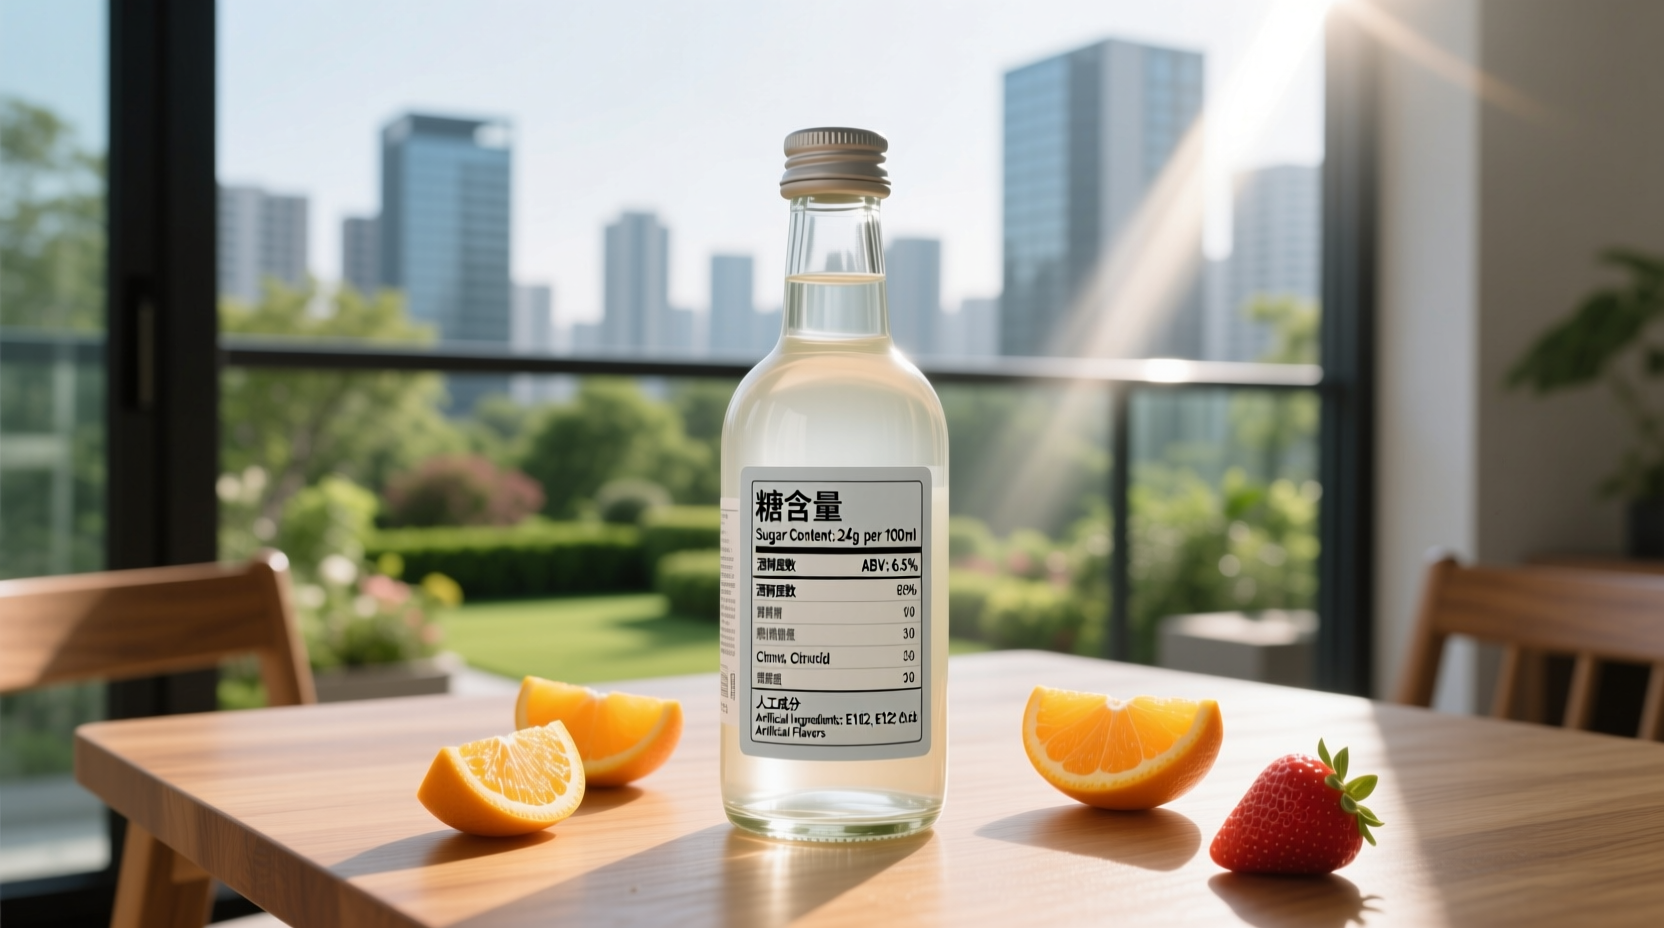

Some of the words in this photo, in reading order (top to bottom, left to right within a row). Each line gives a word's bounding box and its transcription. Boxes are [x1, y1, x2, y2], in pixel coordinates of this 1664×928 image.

[755, 489, 843, 522] 糖含量
[756, 528, 788, 545] Sugar
[789, 528, 835, 542] Content:
[864, 530, 882, 545] per
[886, 528, 917, 542] 100ml
[861, 558, 890, 573] ABV:
